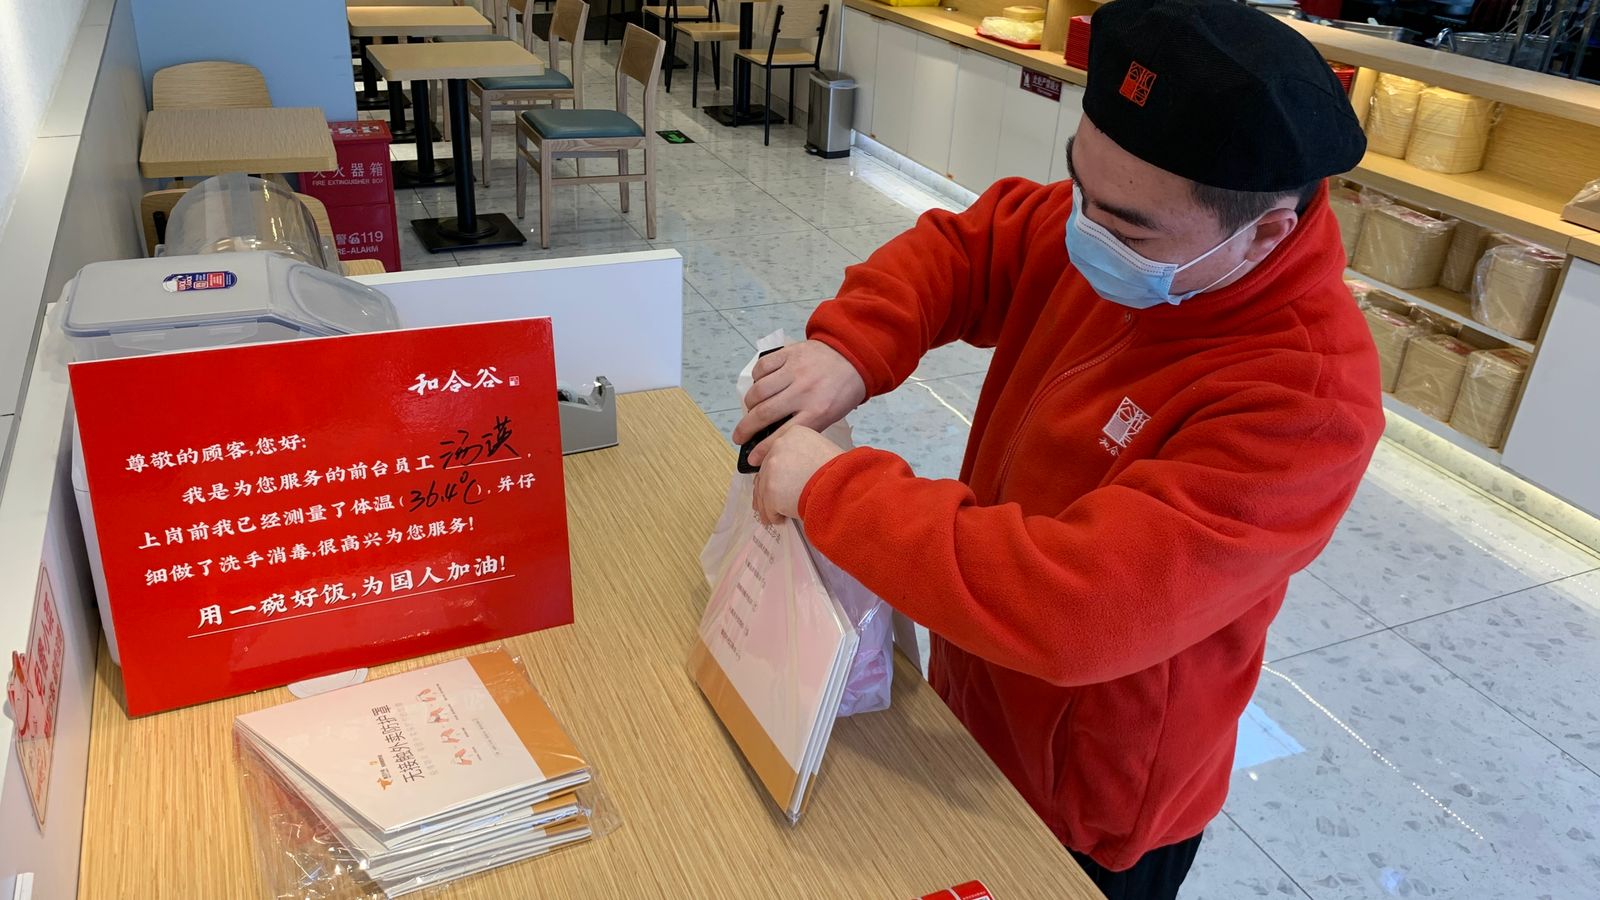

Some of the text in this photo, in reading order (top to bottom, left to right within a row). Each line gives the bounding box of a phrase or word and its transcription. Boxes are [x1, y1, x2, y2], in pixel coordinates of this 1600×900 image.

[361, 230, 384, 243] 119
[408, 366, 503, 396] 和合谷
[125, 434, 307, 473] 尊敬的顾客,您好:
[182, 455, 435, 505] 我是为您服务的前台员工
[145, 516, 474, 586] 细做了洗手消毒,很高兴为您服务!
[197, 554, 507, 630] 用一碗好饭,为国人加油!
